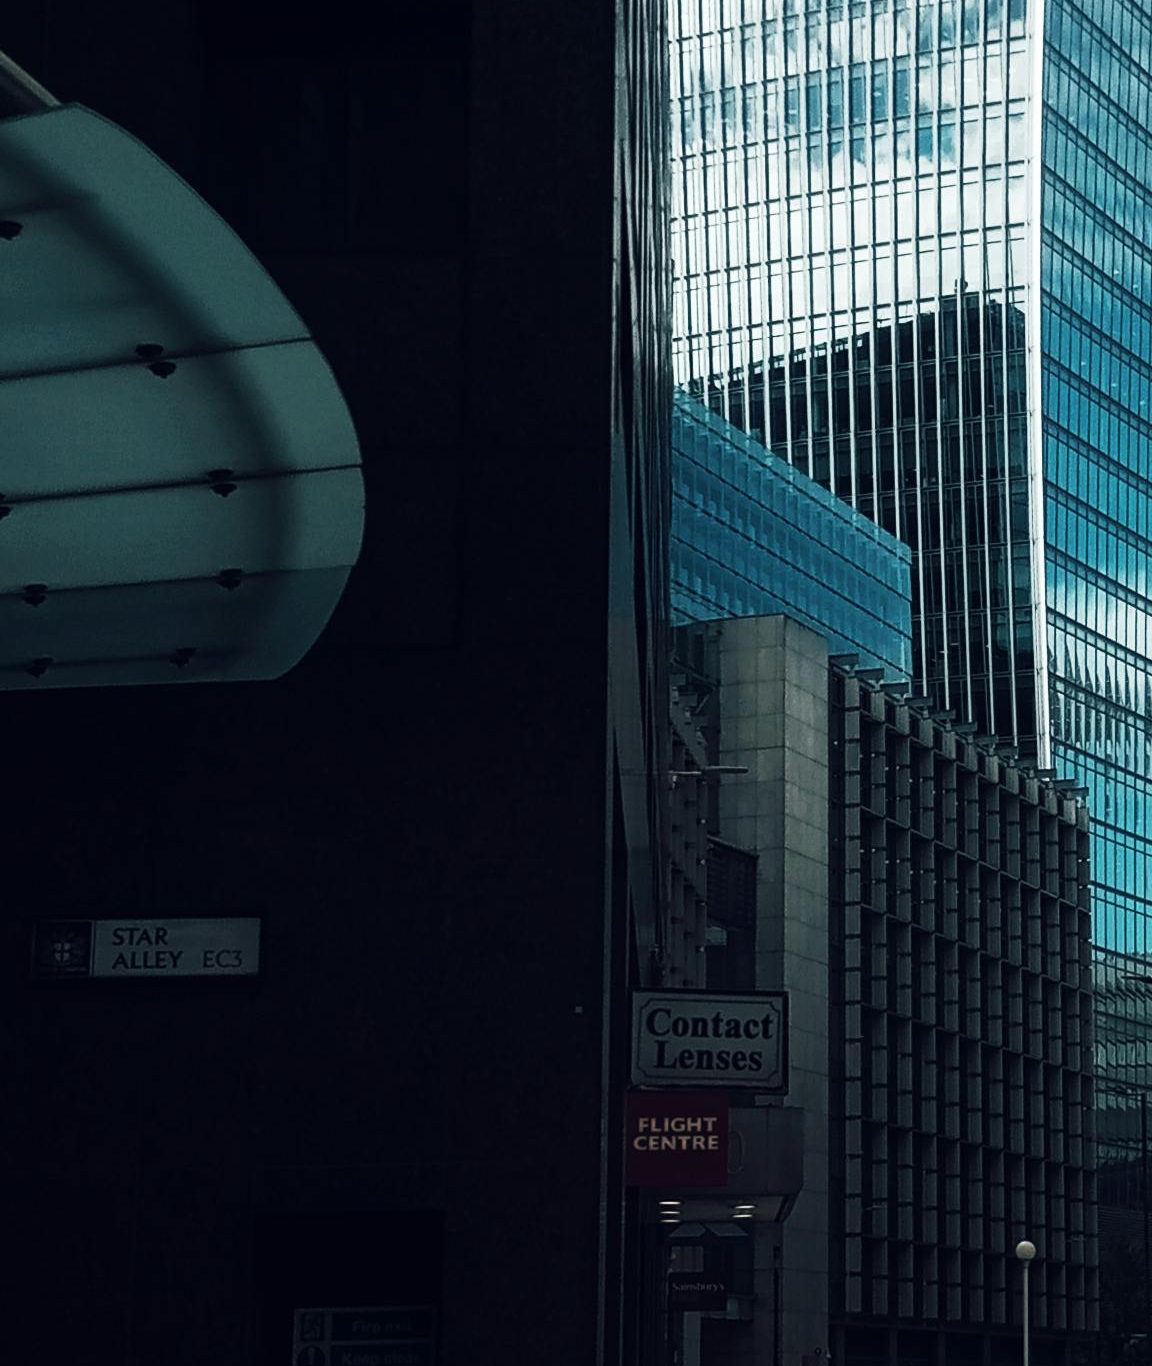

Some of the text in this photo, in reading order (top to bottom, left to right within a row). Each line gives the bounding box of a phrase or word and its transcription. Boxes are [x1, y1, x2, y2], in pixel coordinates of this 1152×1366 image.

[112, 927, 168, 946] STAR
[112, 949, 242, 969] ALLEY EC3
[646, 1008, 773, 1039] Contact
[653, 1040, 763, 1071] Lenses
[637, 1116, 718, 1133] FLIGHT
[633, 1135, 720, 1151] CENTRE
